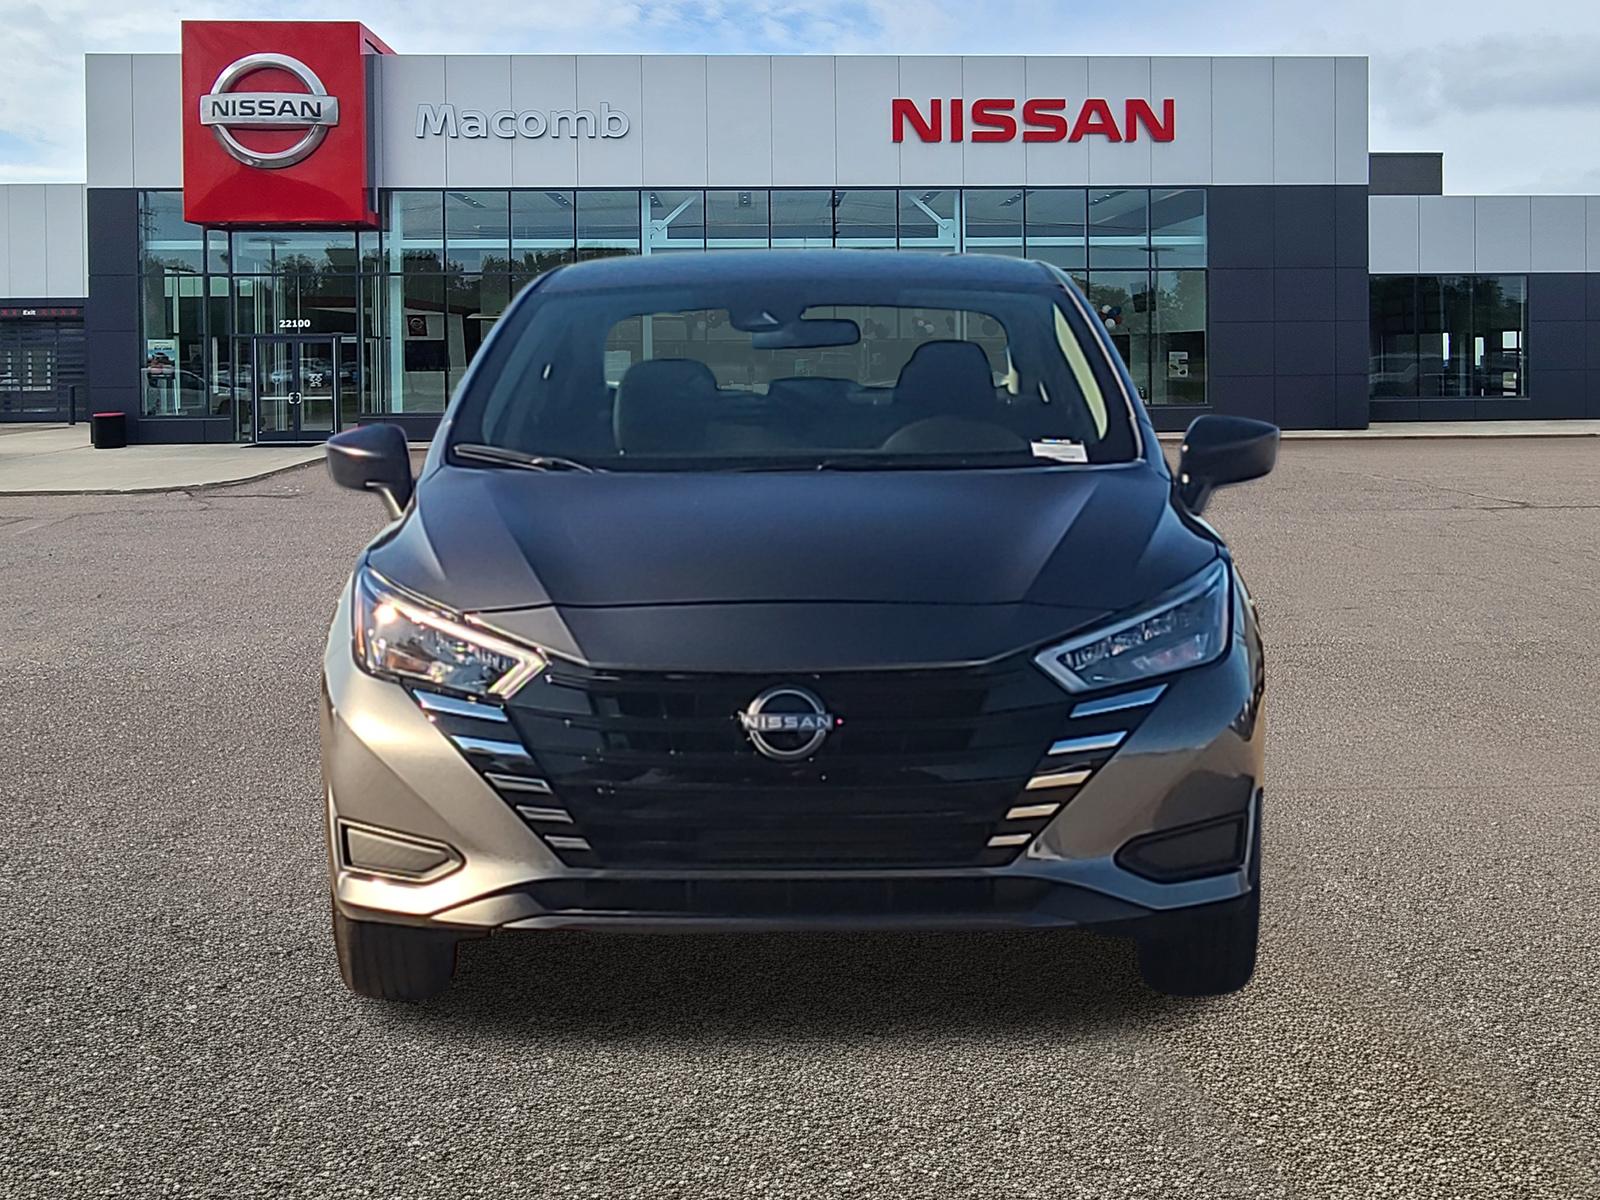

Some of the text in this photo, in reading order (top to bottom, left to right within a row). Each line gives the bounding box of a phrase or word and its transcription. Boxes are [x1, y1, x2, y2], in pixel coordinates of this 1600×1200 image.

[211, 100, 322, 118] NISSAN
[415, 101, 631, 139] Macomb
[892, 98, 1177, 144] NISSAN
[279, 319, 311, 328] 22100
[743, 715, 832, 729] NISSAN
